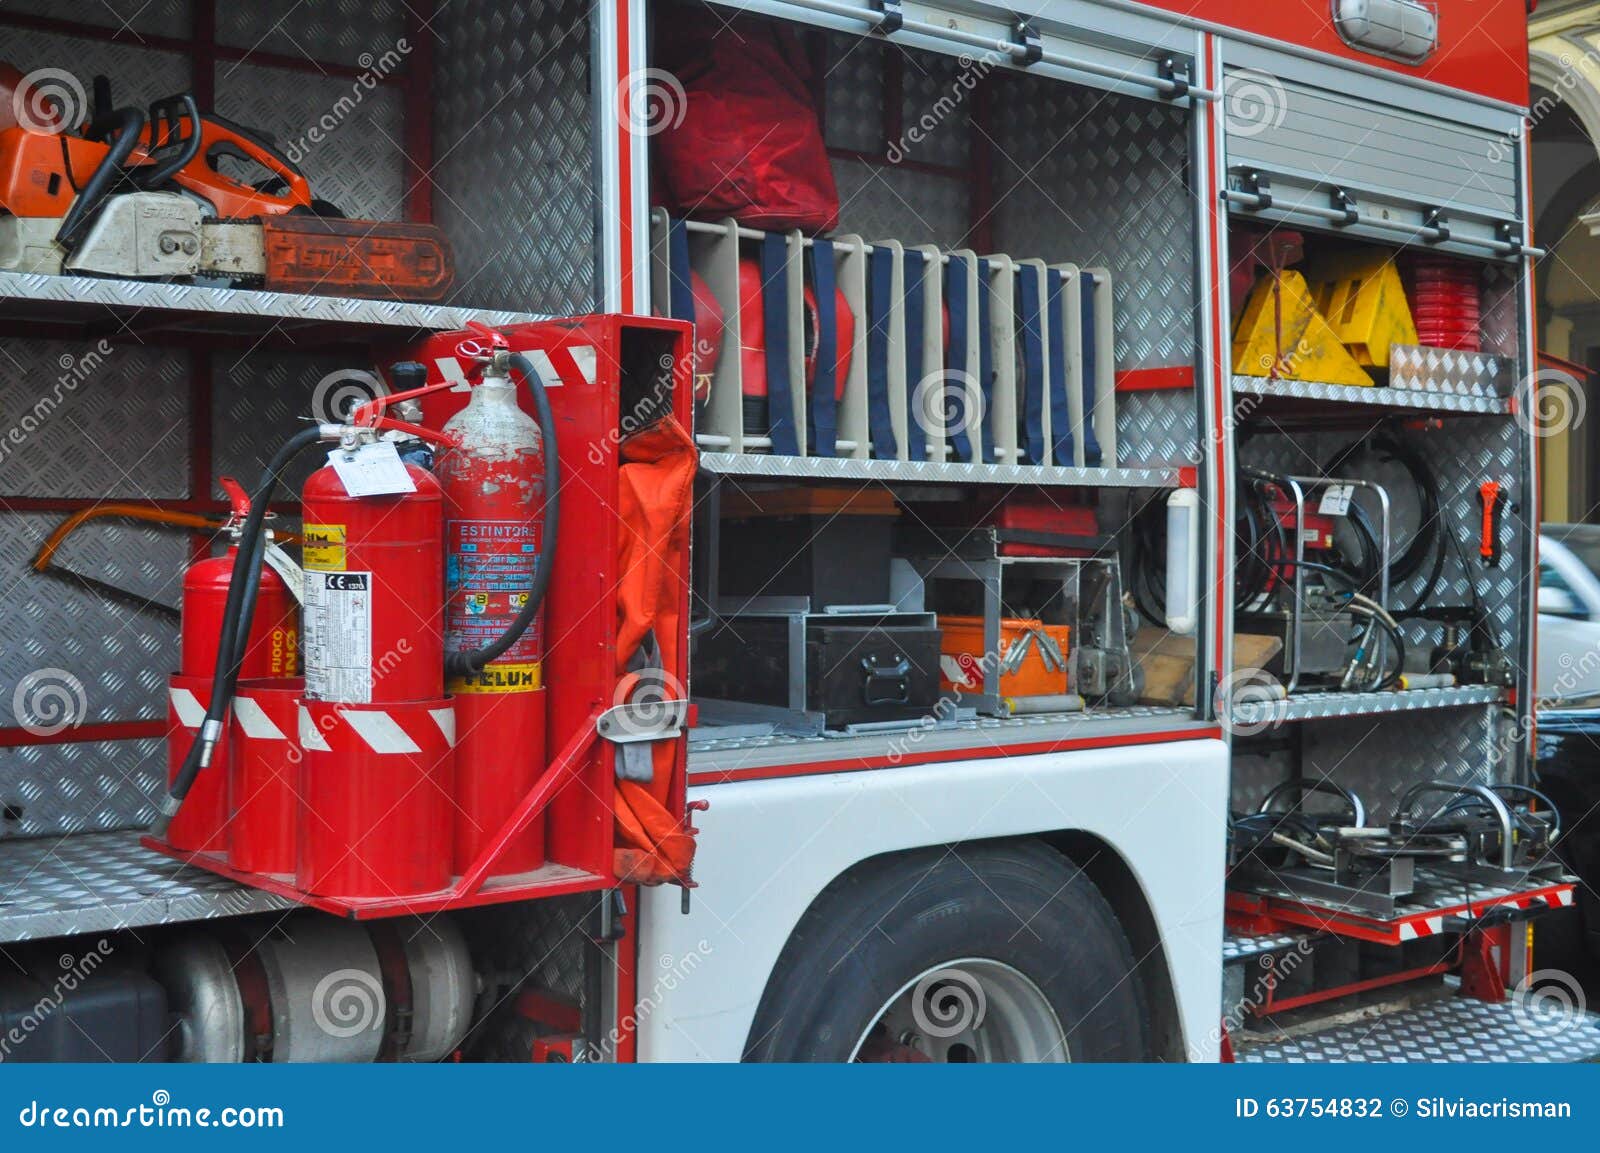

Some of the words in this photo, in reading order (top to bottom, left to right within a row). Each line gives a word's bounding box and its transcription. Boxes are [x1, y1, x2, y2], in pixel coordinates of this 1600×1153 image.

[142, 206, 185, 220] STIHL
[460, 525, 537, 537] ESTINTORE
[271, 630, 283, 673] FUOCO
